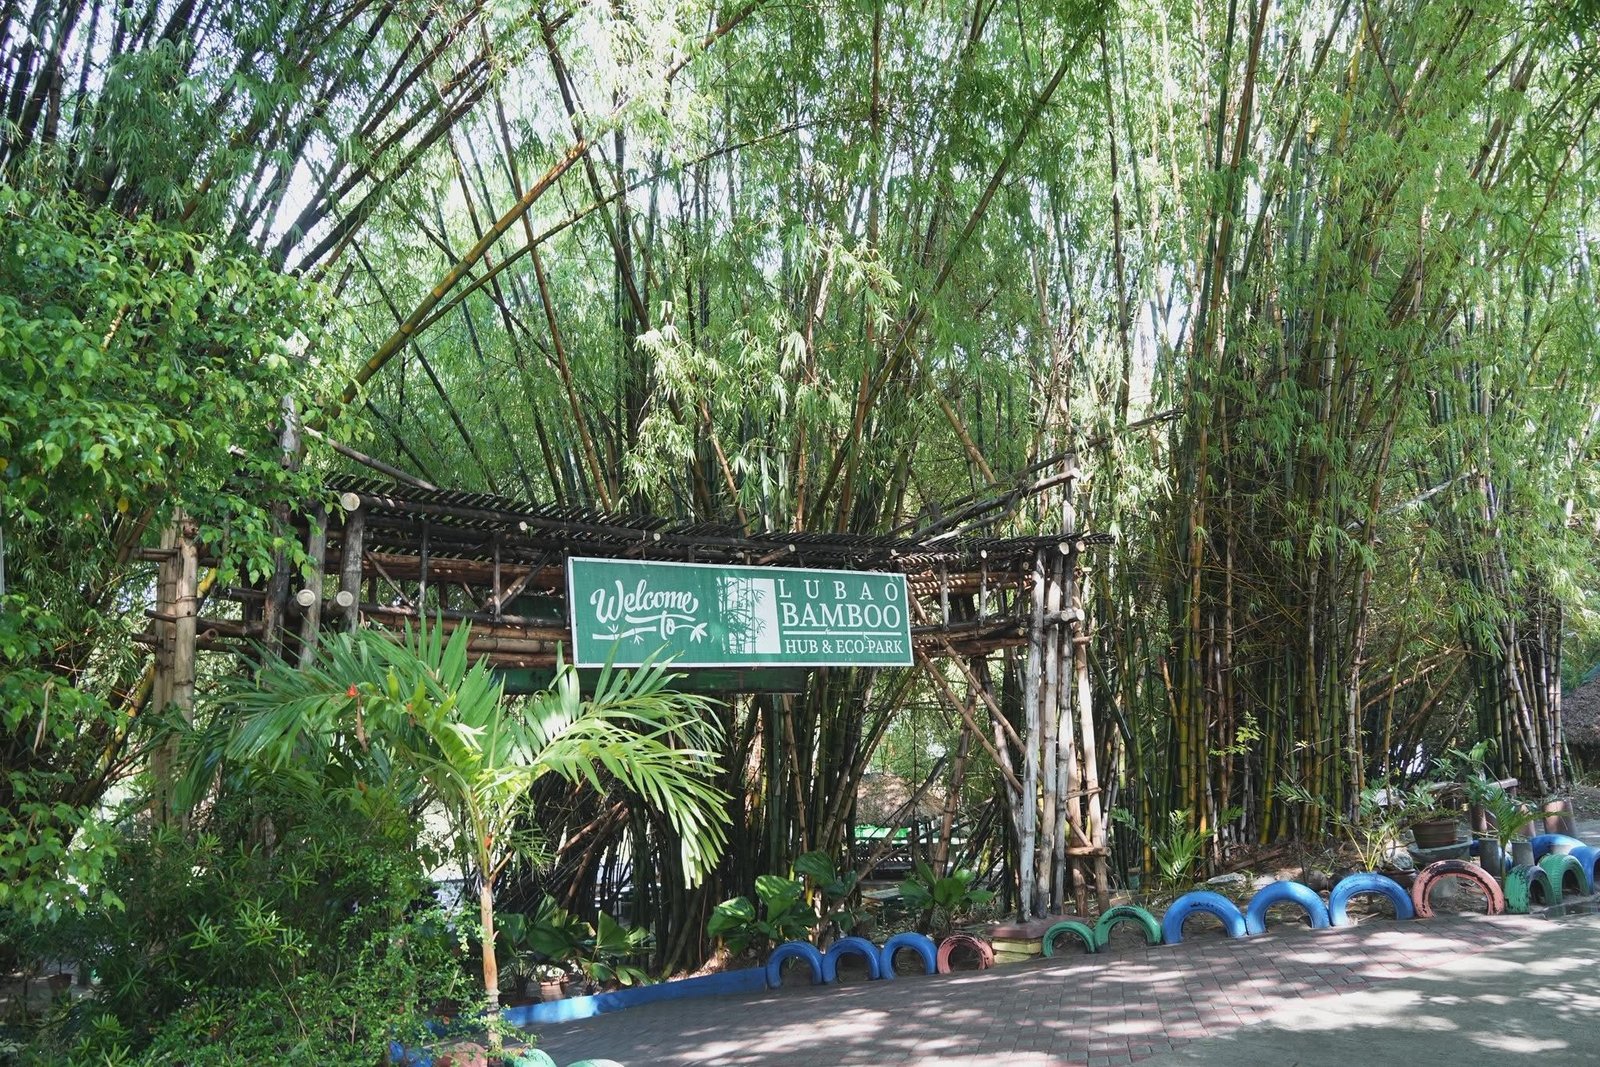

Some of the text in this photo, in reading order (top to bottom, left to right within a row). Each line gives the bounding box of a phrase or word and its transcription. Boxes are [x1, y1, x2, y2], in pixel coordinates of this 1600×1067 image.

[590, 579, 698, 623] Welcome
[777, 578, 898, 600] LUBAO
[660, 612, 675, 640] to
[782, 603, 900, 629] BAMBOO
[785, 639, 903, 654] HUB & ECO-PARK
